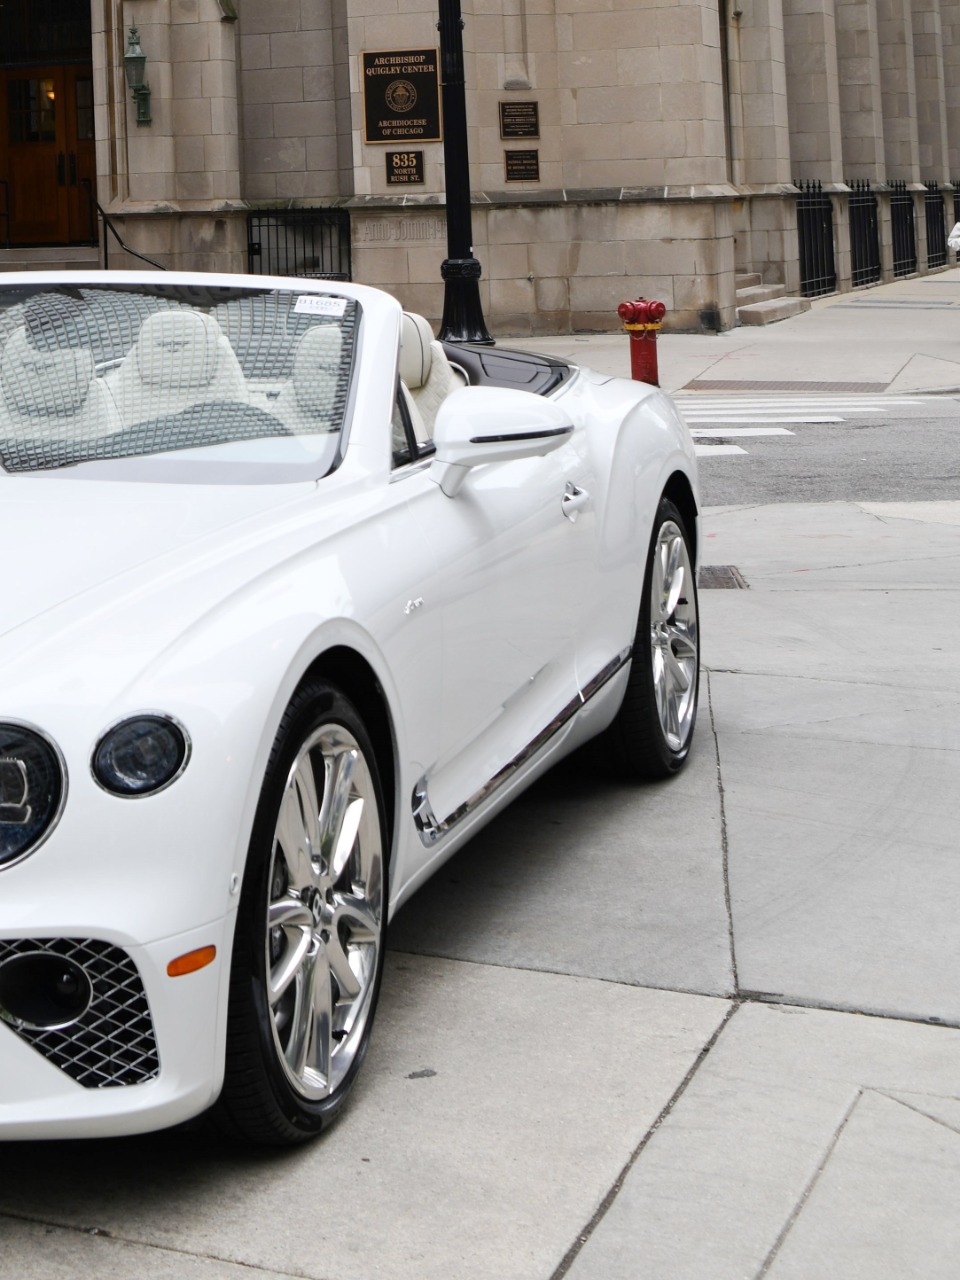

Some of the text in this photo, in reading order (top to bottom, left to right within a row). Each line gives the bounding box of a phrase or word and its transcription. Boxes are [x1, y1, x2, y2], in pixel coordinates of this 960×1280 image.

[374, 55, 426, 65] ARCHBISHOP
[366, 65, 435, 76] QUIGLEY CENTER
[377, 119, 428, 127] ARCHDIOCESE
[392, 127, 424, 135] CHICAGO
[392, 153, 417, 168] 835
